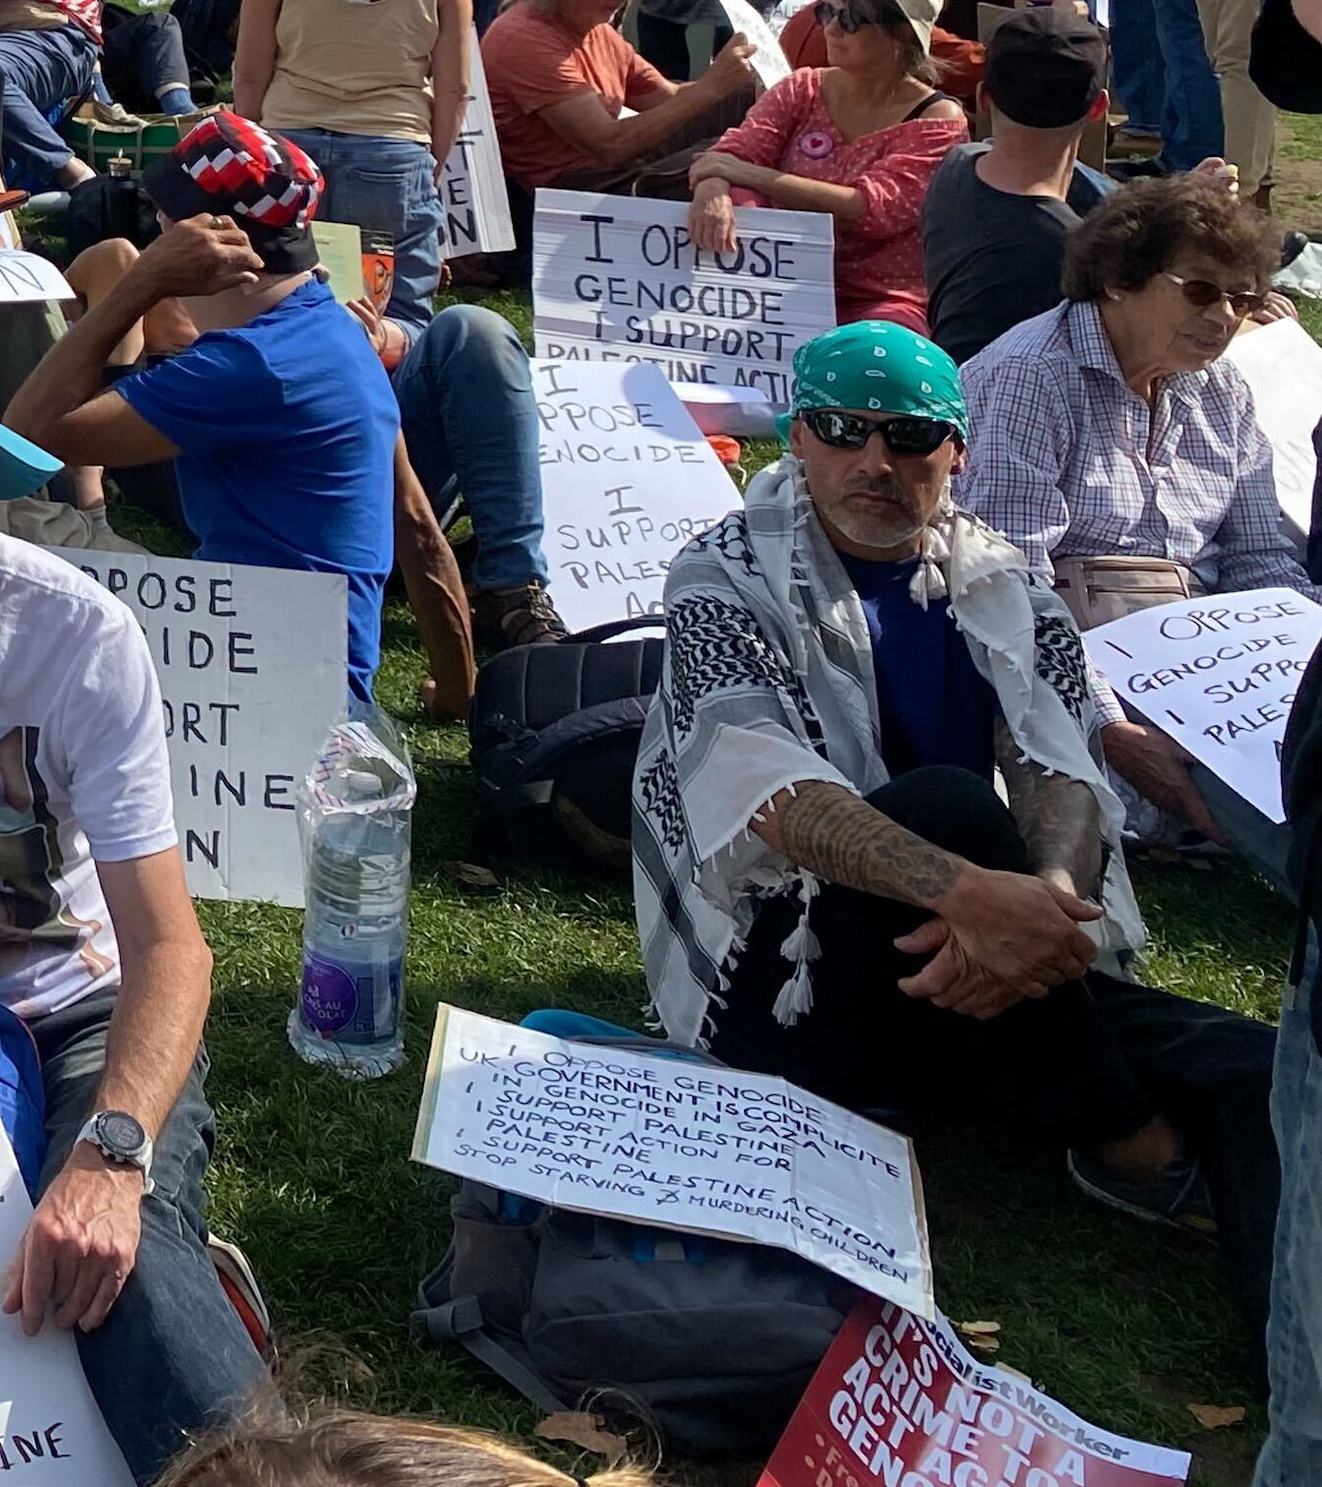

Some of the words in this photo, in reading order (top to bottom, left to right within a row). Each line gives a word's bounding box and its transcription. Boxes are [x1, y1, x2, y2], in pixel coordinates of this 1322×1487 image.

[580, 215, 614, 264] I
[574, 274, 785, 326] GENOCIDE
[592, 311, 607, 342] I
[625, 315, 795, 362] SUPPORT
[539, 364, 578, 397] I
[733, 366, 798, 405] ACTI
[537, 403, 664, 432] PPOSE
[539, 440, 706, 464] ENOCIDE
[605, 485, 644, 516] I
[557, 517, 716, 550] SUPPORT
[80, 566, 237, 617] POSE
[560, 560, 670, 589] PALES
[1104, 640, 1133, 659] I
[1159, 601, 1306, 640] OPPOSE
[1127, 633, 1298, 693] GENOCIDE
[1165, 710, 1185, 725] I
[1204, 659, 1309, 704] SUPPO
[508, 1044, 517, 1057] I
[542, 1050, 659, 1084] OPPOSE
[674, 1075, 828, 1125] GENOCIDE
[466, 1081, 474, 1094] I
[498, 1089, 621, 1123] SUPPORT
[643, 1118, 794, 1157] PALESTINE
[476, 1100, 483, 1113] I
[489, 1102, 612, 1138] SUPPORT
[619, 1131, 719, 1161] ACTION
[735, 1150, 792, 1172] FOR
[486, 1118, 653, 1164] PALESTINE
[493, 1072, 522, 1089] IN
[548, 1085, 677, 1119] GENOCIDE
[693, 1110, 721, 1126] IN
[737, 1118, 827, 1159] GAZA
[514, 1059, 699, 1107] GOVERNMENT
[716, 1100, 737, 1116] IS
[744, 1105, 902, 1179] COMPLICITE
[453, 1143, 517, 1166] STOP
[529, 1162, 646, 1198] STARVING
[687, 1194, 805, 1231] MURDERING
[809, 1226, 909, 1285] CHILDREN
[457, 1128, 466, 1138] I
[484, 1135, 602, 1170] SUPPORT
[613, 1163, 776, 1203] PALESTINE
[783, 1197, 897, 1259] ACTION
[924, 1320, 1014, 1399] ocialist
[842, 1357, 918, 1449] ACT
[865, 1324, 985, 1460] CRIME
[881, 1303, 939, 1389] IT'S
[945, 1383, 1046, 1455] NOT
[1054, 1449, 1087, 1487] A
